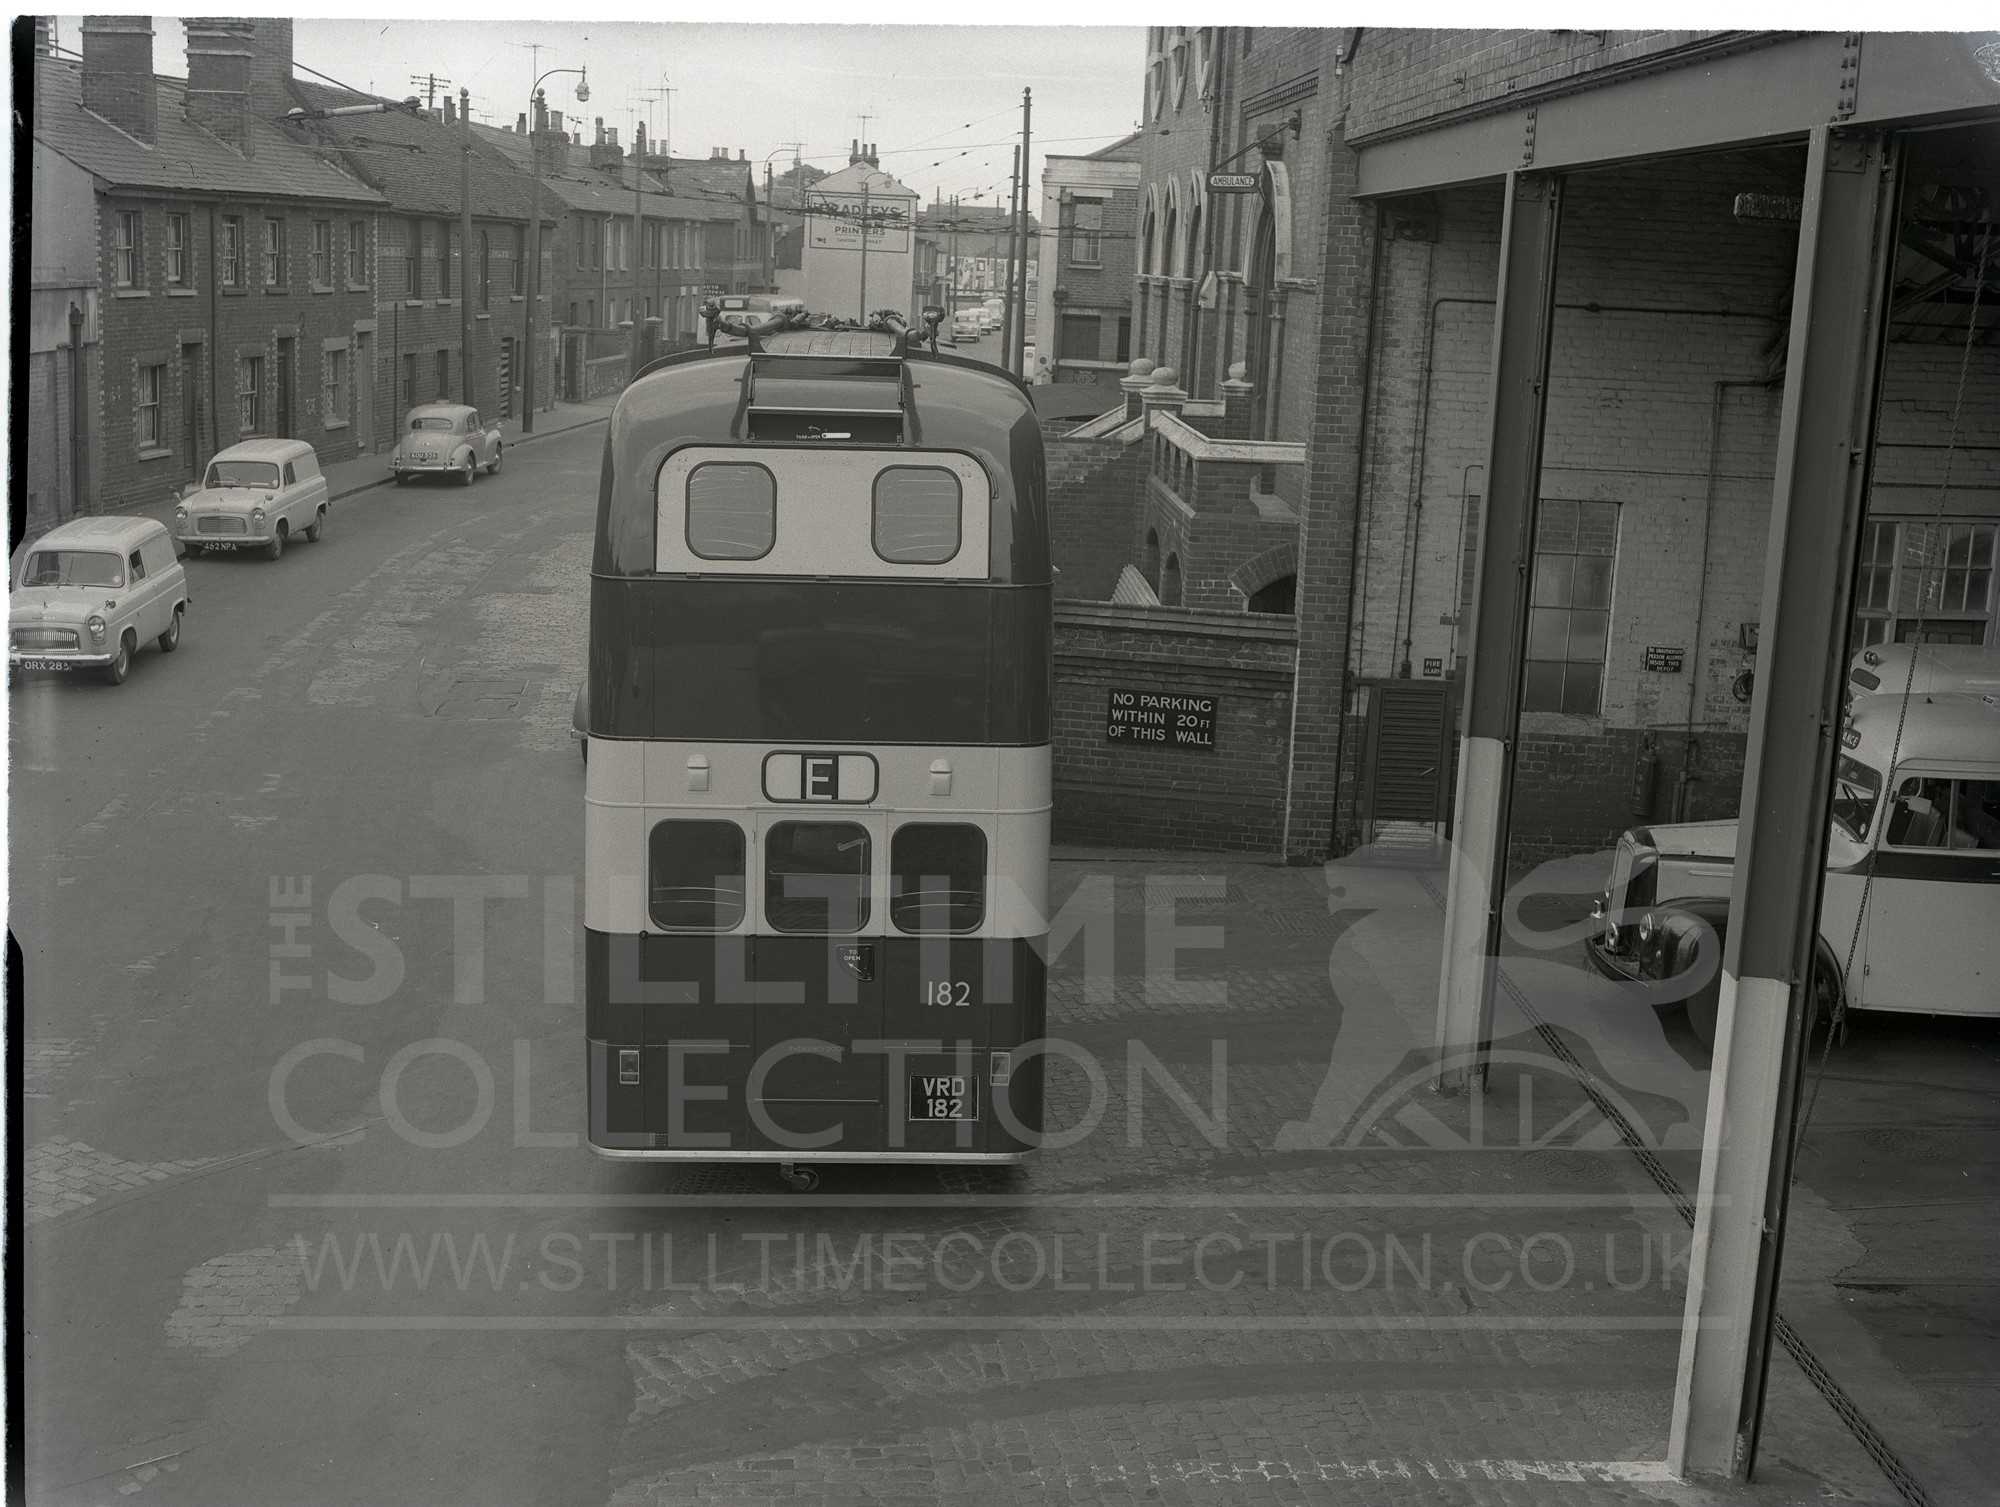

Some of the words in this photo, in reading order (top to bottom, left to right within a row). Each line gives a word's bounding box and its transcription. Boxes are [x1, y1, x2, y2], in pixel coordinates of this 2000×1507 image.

[1213, 177, 1253, 186] AMBULANCE
[24, 661, 46, 671] ORX
[1113, 692, 1135, 706] NO
[1140, 695, 1212, 712] PARKING
[1111, 708, 1165, 725] WITHIN
[1176, 714, 1198, 727] 20
[1200, 719, 1211, 729] FT
[1108, 724, 1127, 737] OF
[1131, 726, 1166, 741] THIS
[1175, 730, 1212, 744] WALL
[806, 758, 833, 800] E
[927, 981, 970, 1006] 182
[922, 1077, 965, 1096] VRD
[927, 1098, 962, 1117] 182
